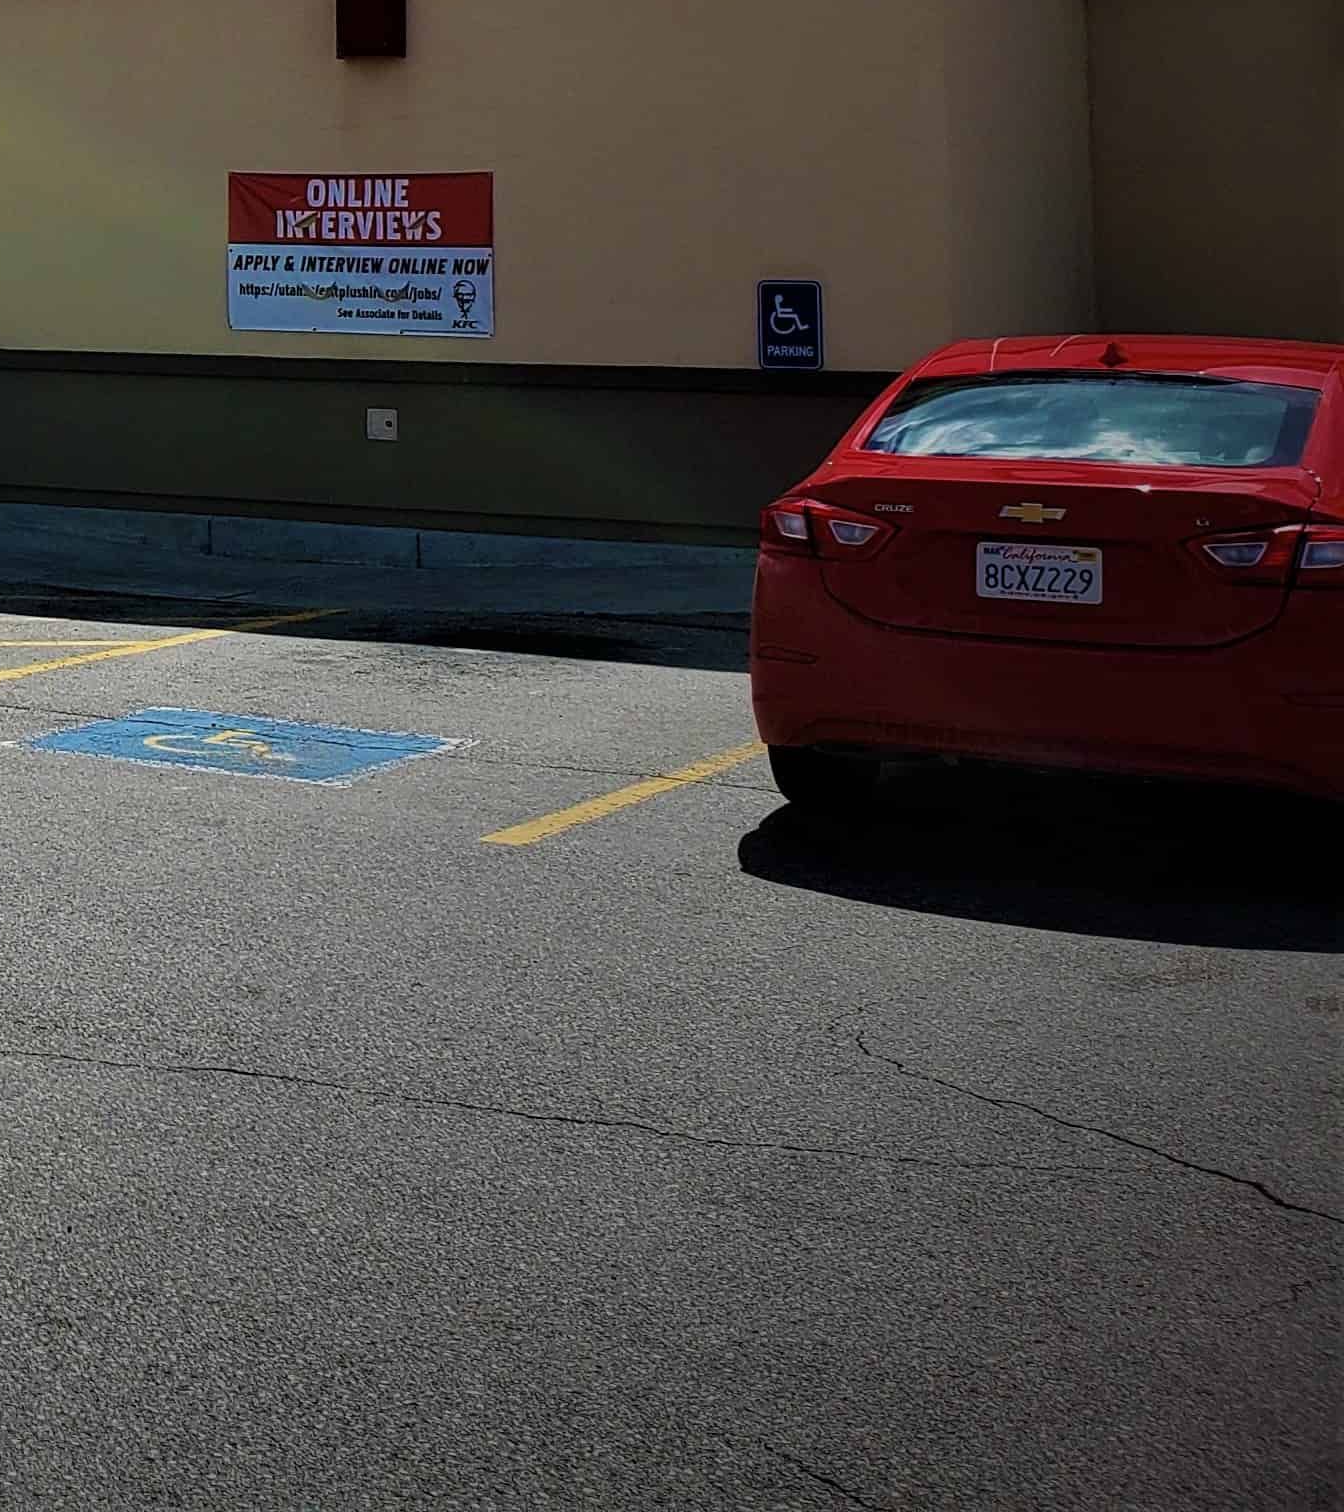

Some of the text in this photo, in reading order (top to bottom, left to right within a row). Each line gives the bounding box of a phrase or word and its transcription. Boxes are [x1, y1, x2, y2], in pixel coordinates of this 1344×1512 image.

[306, 178, 409, 208] ONLINE
[233, 255, 490, 276] APPLY & INTERVIEW ONLINE NOW
[338, 308, 442, 321] See Associate for Details
[452, 320, 478, 329] KFC
[768, 345, 814, 357] PARKING
[874, 503, 914, 512] CRUZE
[1002, 546, 1074, 564] California
[985, 563, 1093, 594] 8CXZ229
